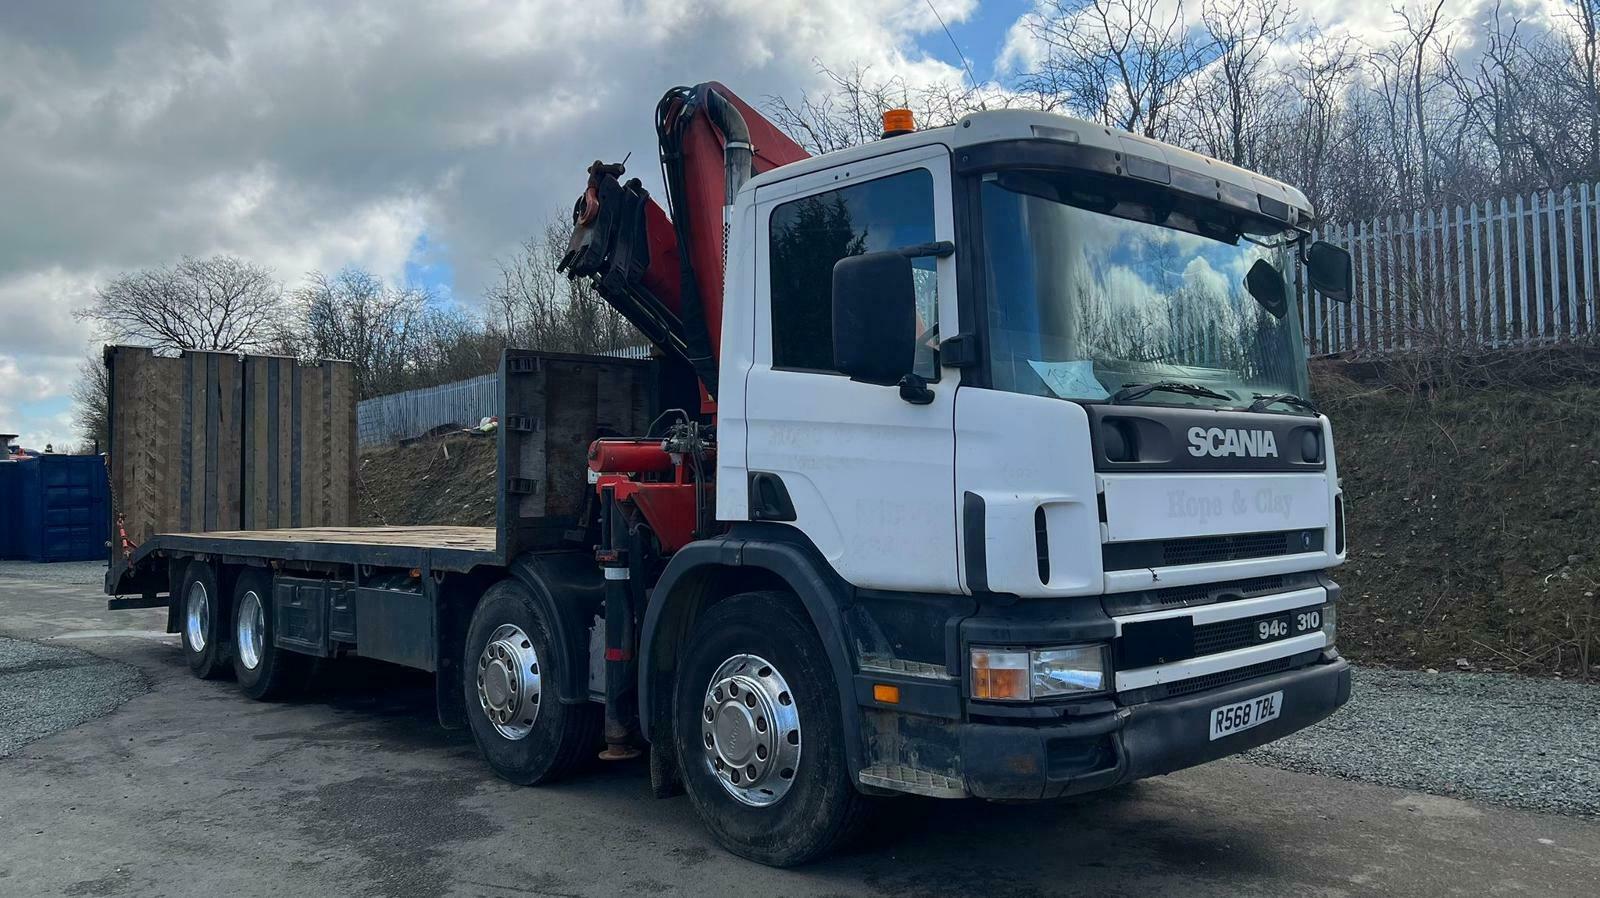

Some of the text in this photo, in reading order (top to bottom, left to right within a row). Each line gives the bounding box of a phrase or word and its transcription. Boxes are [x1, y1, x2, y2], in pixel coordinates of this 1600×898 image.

[1187, 426, 1278, 458] SCANIA
[1231, 488, 1248, 515] &
[1297, 611, 1320, 631] 310
[1214, 695, 1275, 735] R568 TBL
